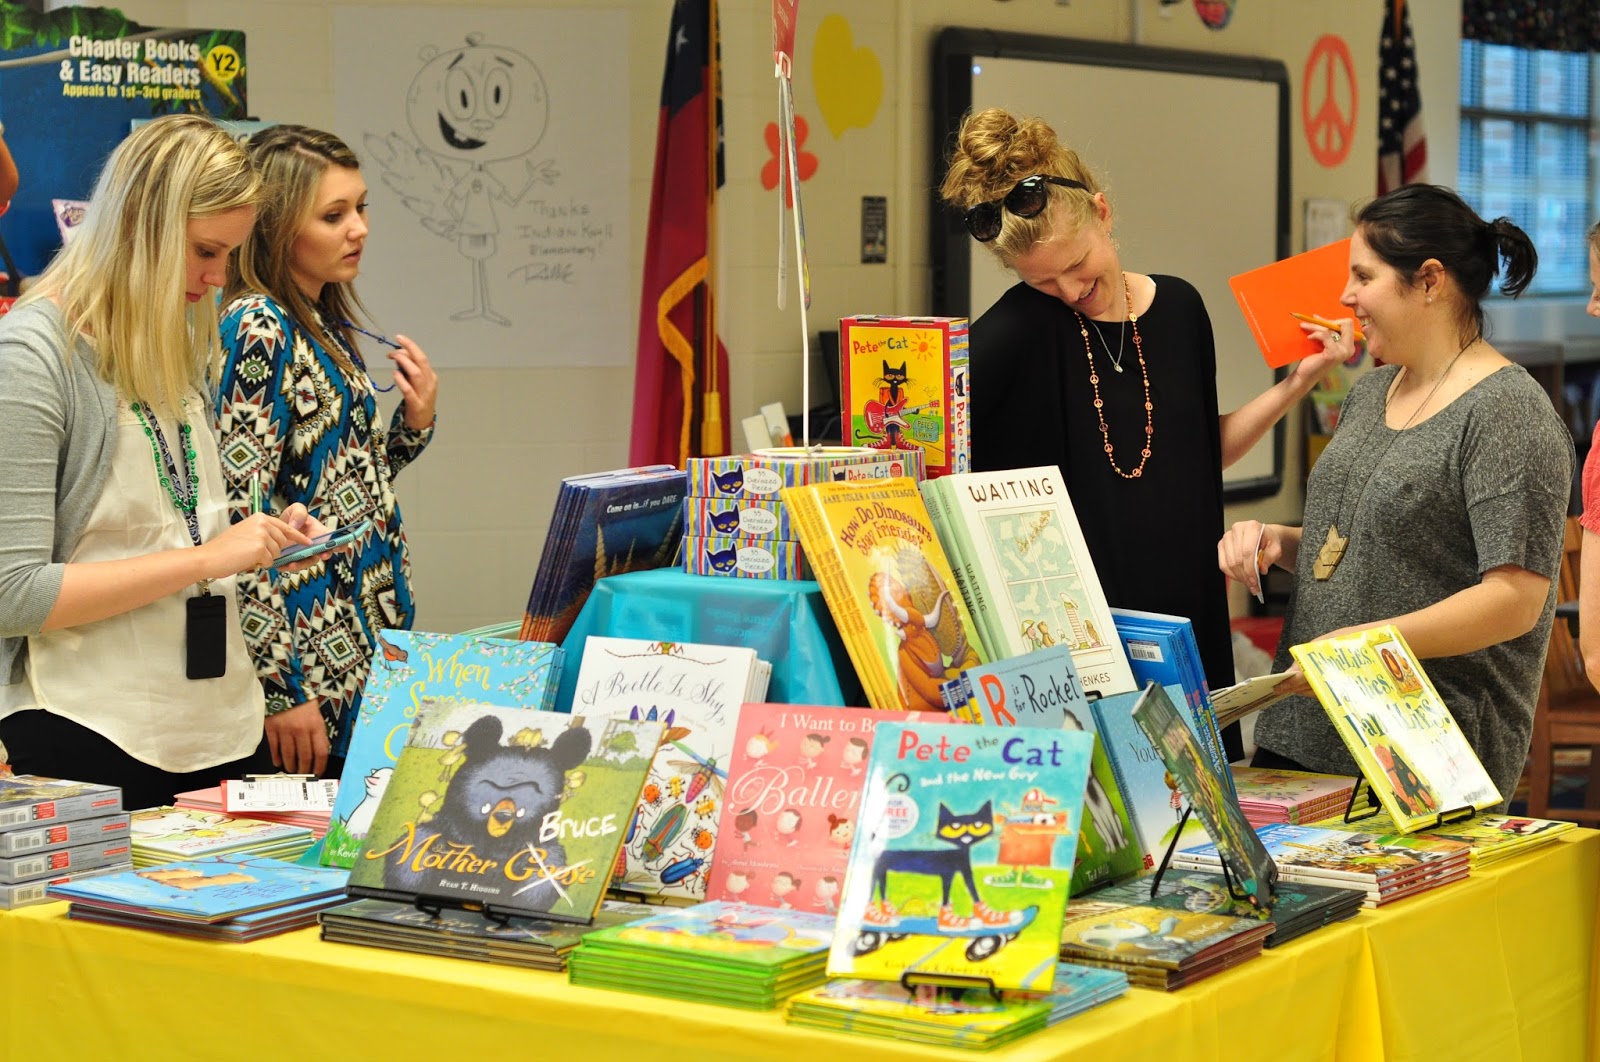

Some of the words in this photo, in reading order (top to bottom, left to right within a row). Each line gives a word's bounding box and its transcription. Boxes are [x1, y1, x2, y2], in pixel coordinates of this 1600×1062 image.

[69, 36, 140, 61] Chapter
[145, 38, 200, 62] Books
[212, 53, 235, 71] Y2
[60, 59, 74, 81] &
[80, 60, 122, 85] Easy
[127, 62, 200, 85] Readers
[63, 83, 104, 98] Appeals
[107, 85, 117, 97] to
[162, 87, 200, 100] graders
[853, 340, 878, 354] Pete
[888, 337, 908, 350] Cat
[956, 402, 964, 436] Pete
[874, 466, 889, 479] Cat
[958, 453, 966, 472] Ca
[968, 477, 1054, 503] WAITING
[606, 504, 623, 514] Come
[624, 503, 632, 511] on
[650, 499, 660, 508] you
[841, 516, 860, 548] How
[856, 506, 874, 524] Do
[872, 502, 932, 542] Dinosaurs
[856, 529, 876, 556] Stay
[873, 520, 924, 550] Friends?
[961, 562, 990, 612] WAITING
[422, 649, 490, 690] When
[580, 680, 600, 708] A
[604, 665, 663, 698] Beetle
[664, 673, 687, 698] Is
[690, 678, 726, 726] Shy
[979, 674, 1016, 726] R
[1013, 685, 1020, 696] is
[1020, 666, 1080, 713] Rocket
[1014, 699, 1026, 714] for
[780, 713, 787, 728] I
[794, 714, 834, 731] Want
[840, 720, 856, 732] to
[897, 730, 972, 762] Pete
[976, 736, 999, 750] the
[1002, 737, 1063, 767] Cat
[1130, 742, 1158, 763] You
[728, 764, 862, 816] Baller
[920, 774, 944, 788] and
[947, 771, 970, 783] the
[972, 768, 1006, 781] New
[1008, 766, 1038, 782] Guy
[887, 808, 907, 817] REE
[366, 821, 498, 876] Mother
[502, 847, 596, 886] Goose
[460, 881, 468, 890] T.
